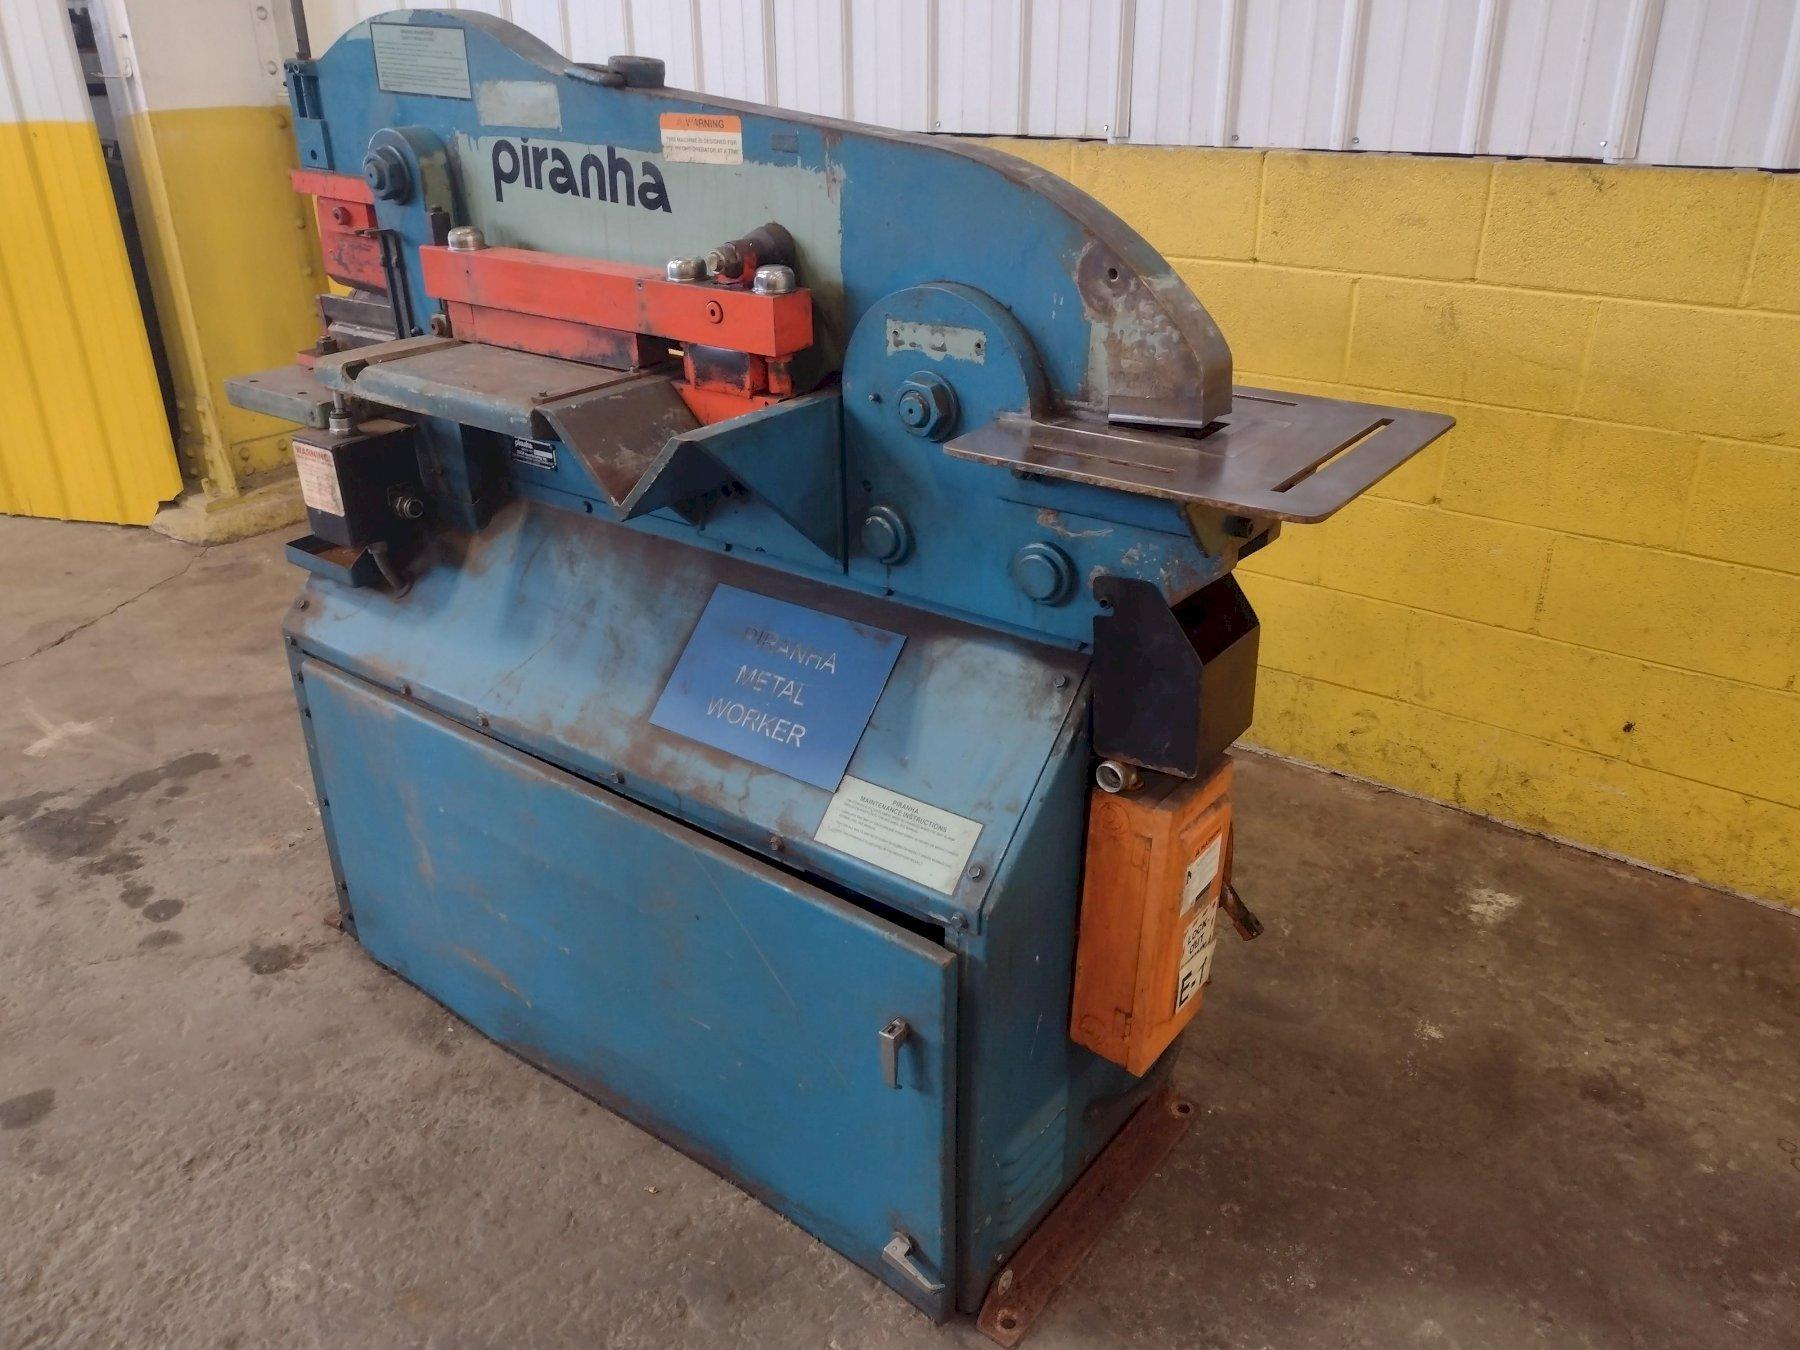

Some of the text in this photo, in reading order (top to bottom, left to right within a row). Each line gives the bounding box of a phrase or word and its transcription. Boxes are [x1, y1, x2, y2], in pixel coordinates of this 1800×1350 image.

[685, 117, 725, 129] WARNING
[491, 137, 673, 213] piranha
[736, 664, 806, 706] METAL
[706, 696, 807, 748] WORKER
[860, 795, 903, 817] MAINTENANCE
[902, 811, 948, 833] INSTRUCTIONS
[892, 799, 919, 814] PIRANHA
